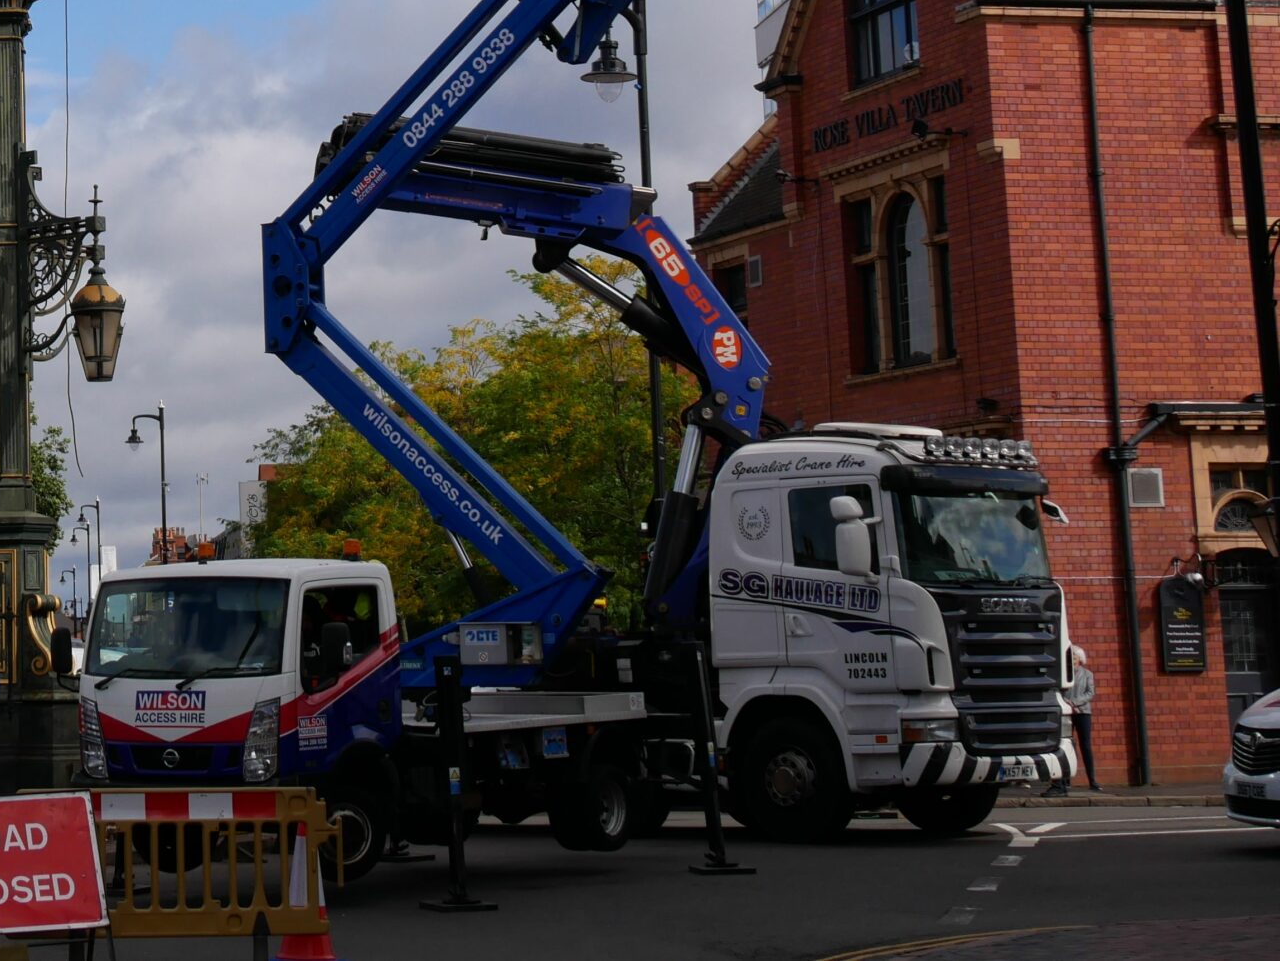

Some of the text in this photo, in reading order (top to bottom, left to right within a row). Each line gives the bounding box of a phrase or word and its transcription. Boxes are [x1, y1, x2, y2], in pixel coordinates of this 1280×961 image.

[402, 27, 515, 149] 0844 288 9338
[812, 78, 964, 153] ROSE VILLA TAVERN
[351, 164, 382, 198] WILSON
[356, 169, 388, 204] ACCESS HIRE
[714, 330, 738, 363] PM
[362, 403, 504, 545] wilsonaccess.co.uk
[732, 454, 866, 480] Specialist Crane Hire
[720, 569, 880, 611] SG HAULAGE LTD
[844, 652, 888, 664] LINCOLN
[847, 668, 887, 679] 702443
[138, 692, 203, 710] WILSON
[135, 712, 205, 724] ACCESS HIRE
[299, 717, 325, 727] WILSON
